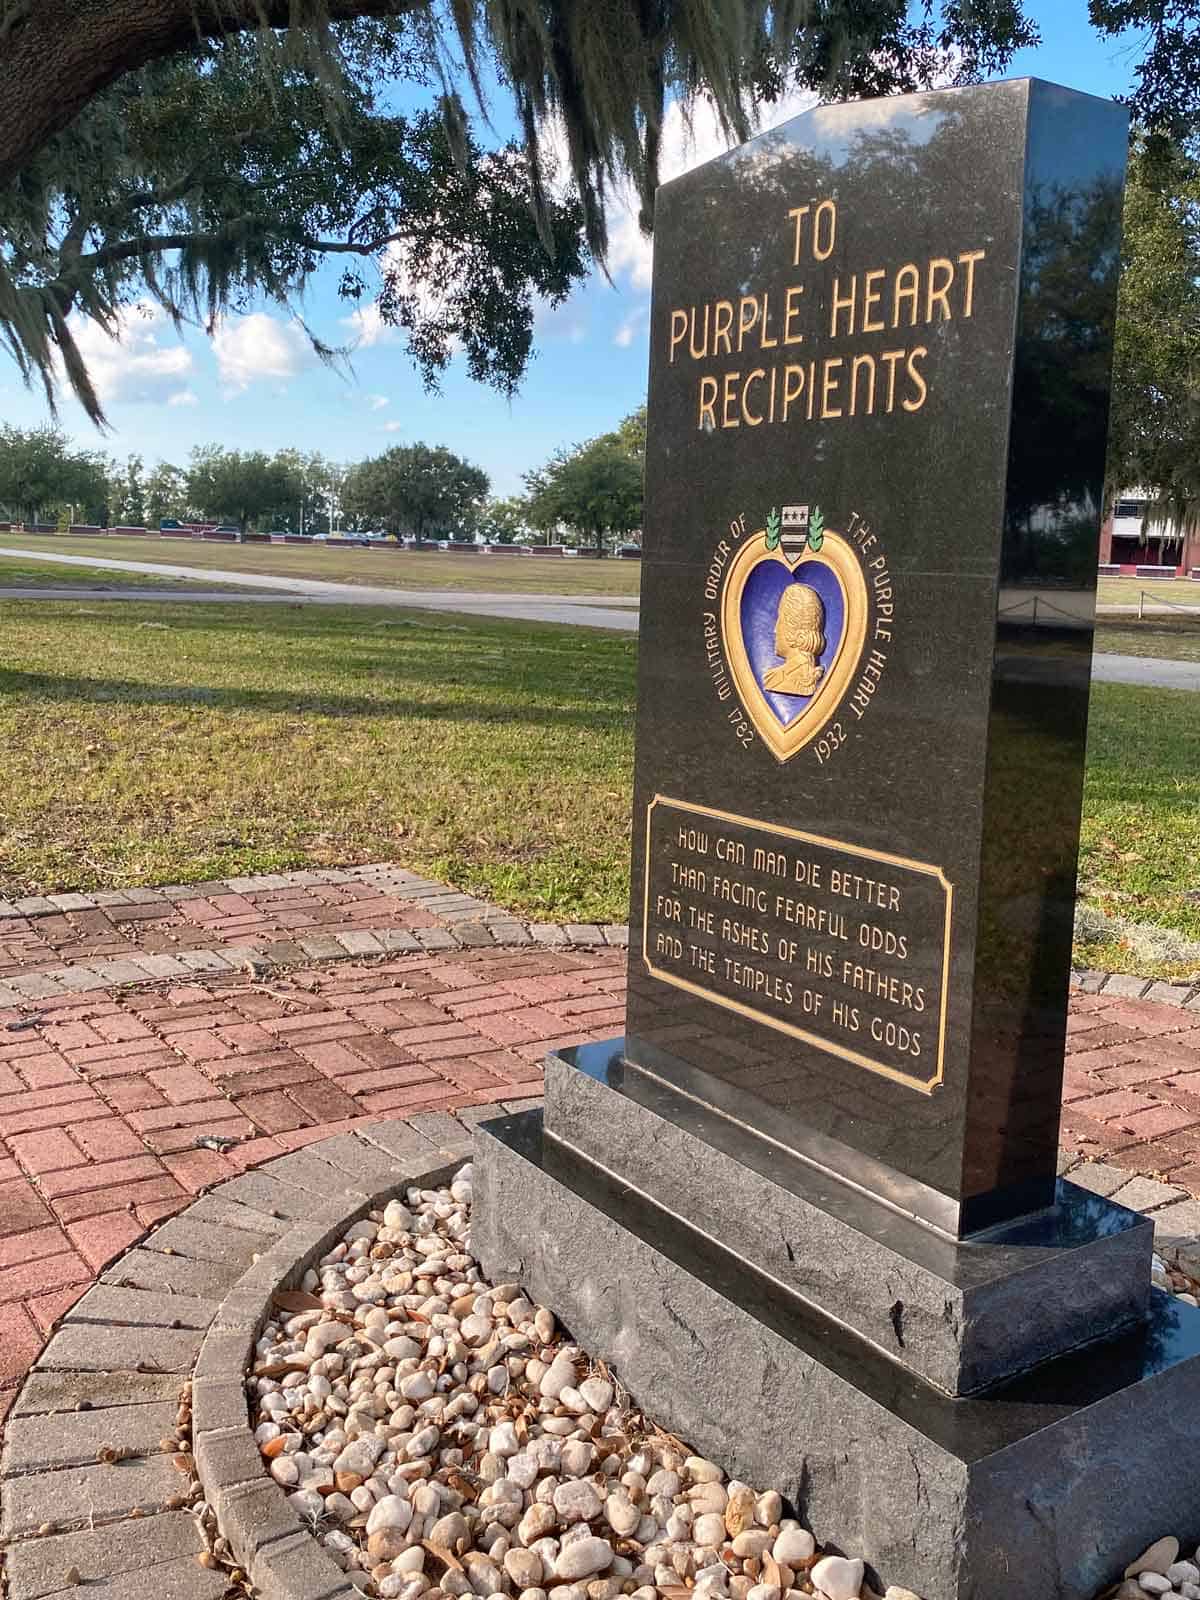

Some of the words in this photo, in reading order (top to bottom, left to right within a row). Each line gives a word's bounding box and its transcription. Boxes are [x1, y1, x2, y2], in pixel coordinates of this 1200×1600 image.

[788, 199, 836, 266] TO
[669, 285, 804, 363] PURPLE
[829, 249, 986, 338] HEART
[698, 346, 928, 430] RECIPIENTS
[730, 511, 746, 540] OF
[845, 511, 877, 555] THE
[704, 540, 731, 600] ORDER
[870, 555, 894, 643] PURPLE
[703, 612, 732, 701] MILITARY
[848, 648, 887, 721] HEART
[727, 706, 756, 749] 1782
[813, 721, 847, 764] 1932
[671, 862, 706, 893] THAN
[712, 876, 768, 913] FACING
[775, 895, 849, 941] FEARFUL
[858, 923, 908, 960] ODDS
[678, 826, 708, 854] HOW
[716, 838, 745, 866] CAN
[752, 847, 787, 878] MAN
[795, 860, 822, 888] DIE
[830, 869, 901, 912] BETTER
[656, 895, 681, 923] FOR
[688, 906, 715, 936] THE
[721, 919, 769, 955] ASHES
[778, 938, 798, 964] OF
[806, 947, 833, 978] HIS
[843, 961, 926, 1012] FATHERS
[656, 932, 683, 959] AND
[690, 944, 716, 975] THE
[724, 957, 793, 1005] TEMPLES
[802, 989, 824, 1016] OF
[832, 999, 859, 1032] HIS
[871, 1016, 921, 1057] GODS
